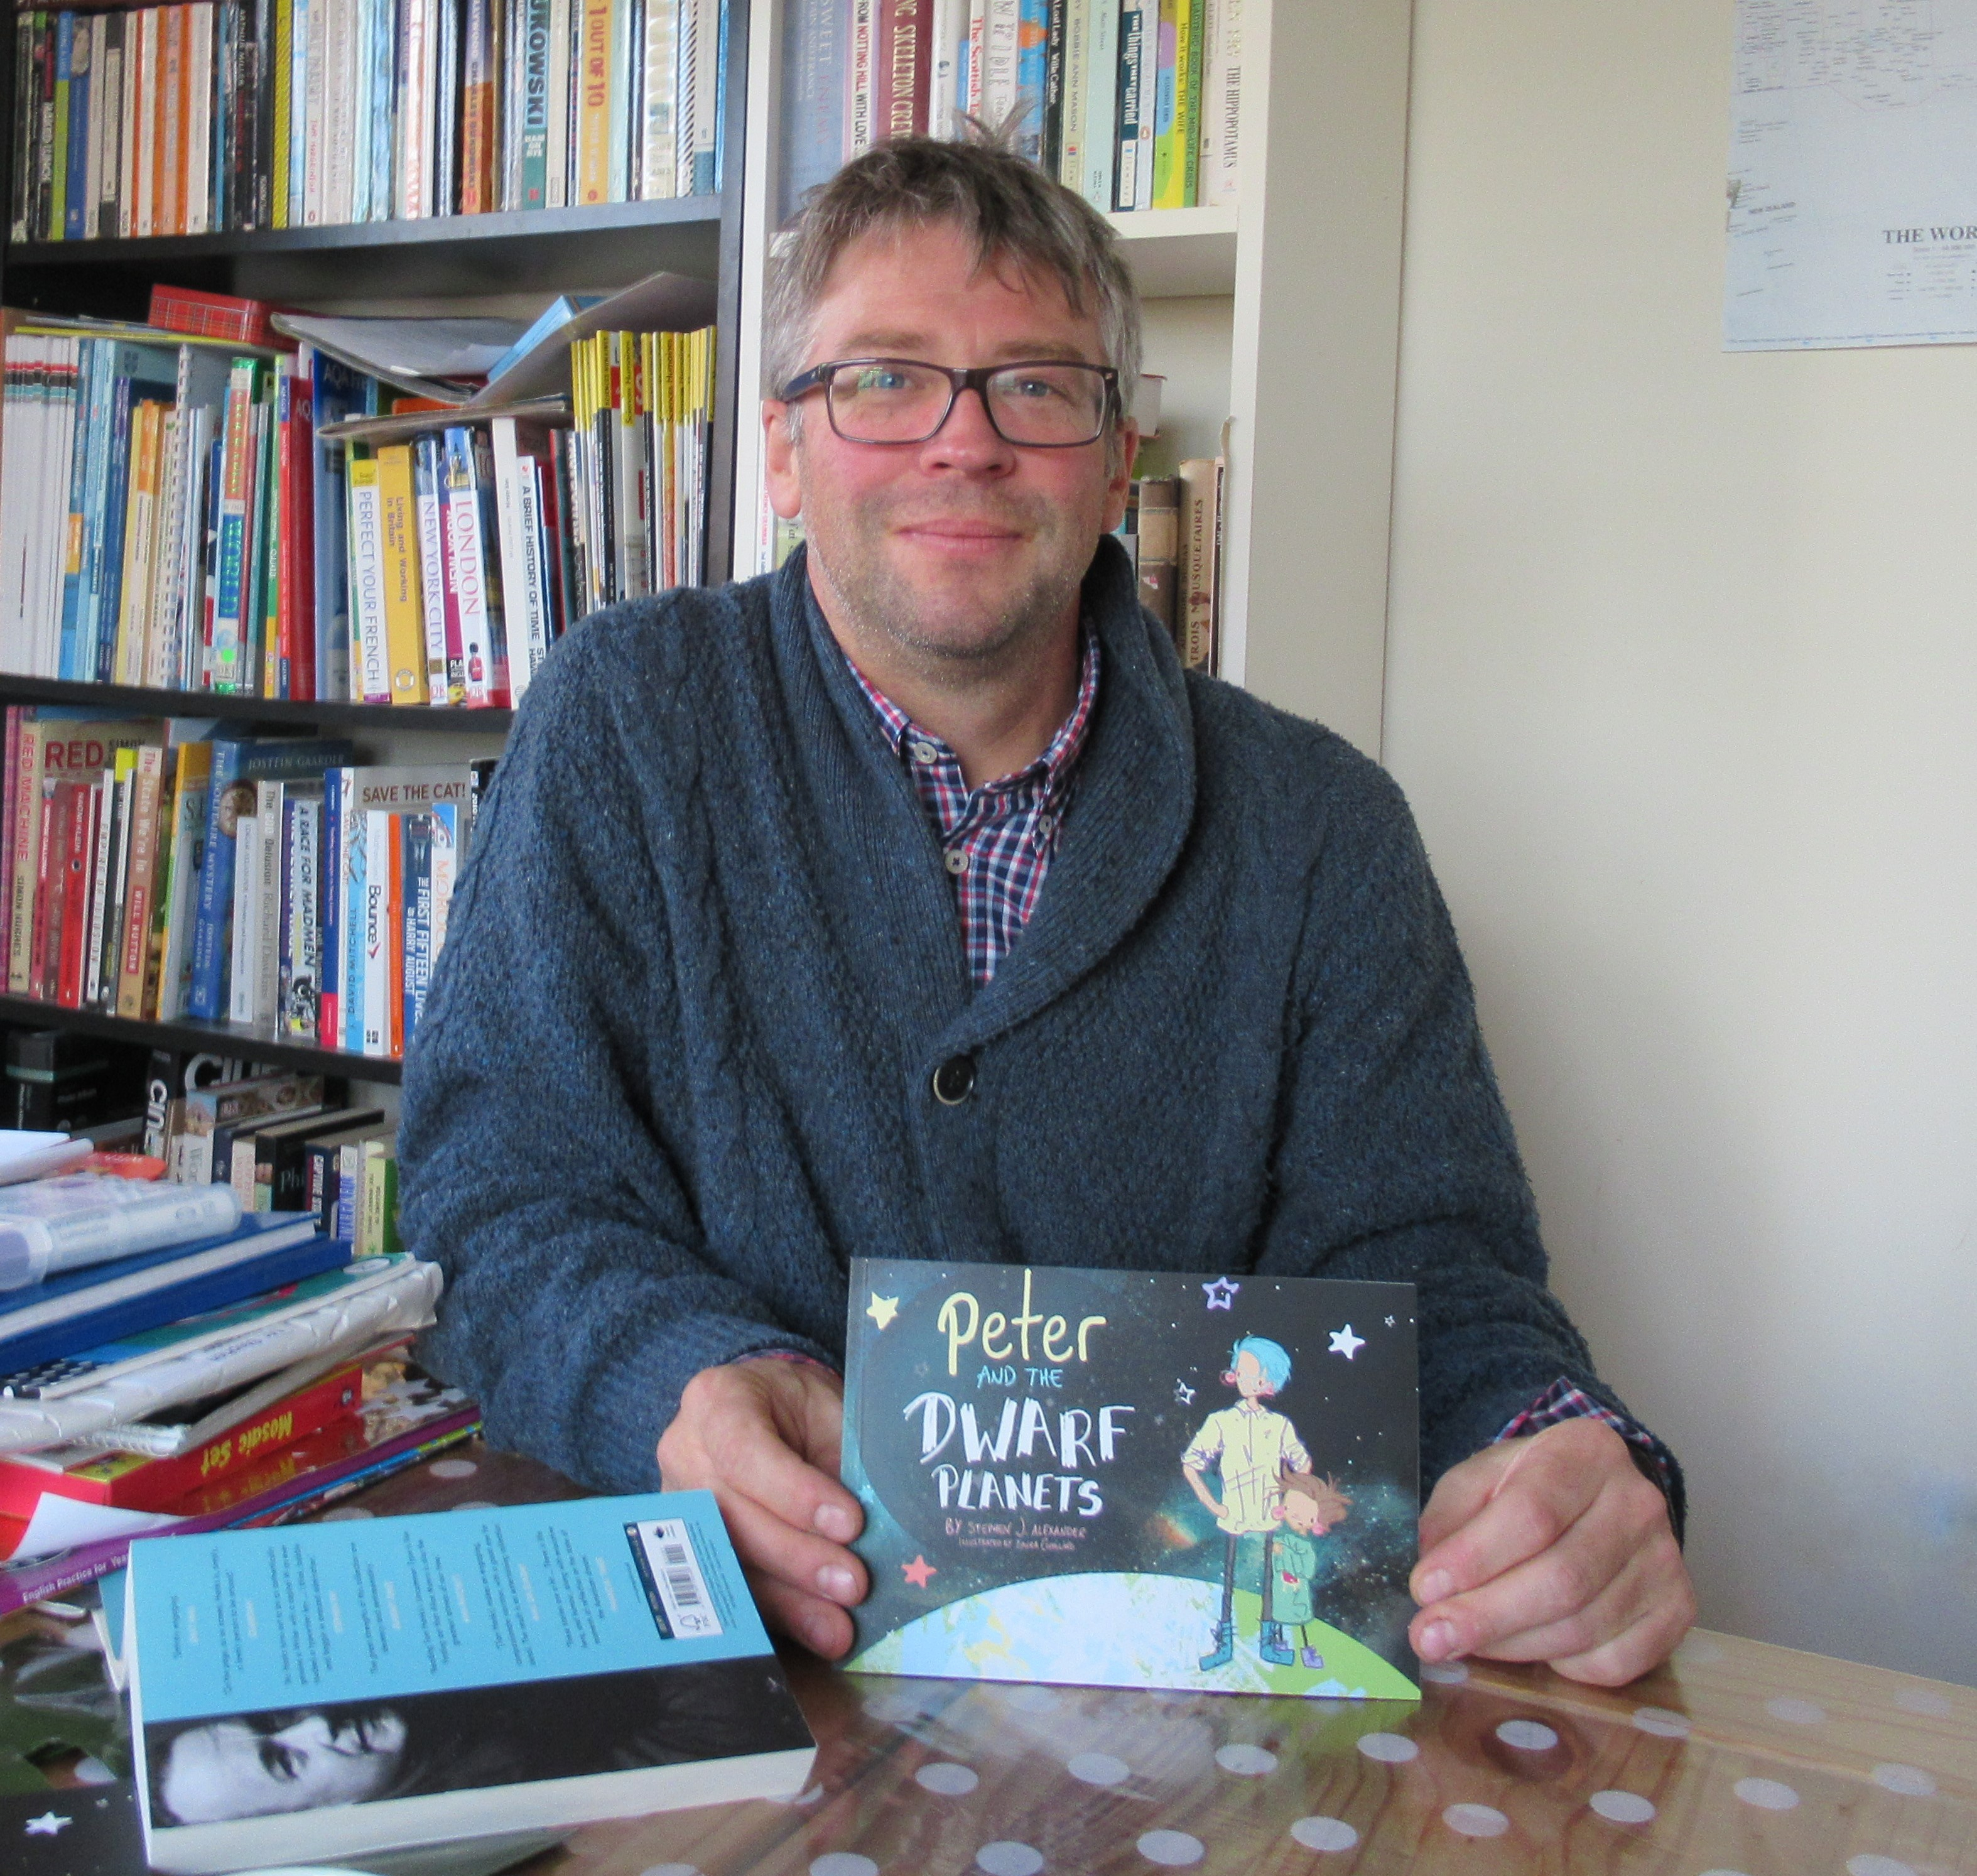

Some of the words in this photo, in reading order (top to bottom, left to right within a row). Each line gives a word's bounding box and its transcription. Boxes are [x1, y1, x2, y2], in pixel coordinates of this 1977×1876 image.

[471, 0, 481, 57] LLYWOOD
[857, 0, 870, 23] ROM
[1053, 4, 1062, 23] Lost
[589, 19, 604, 53] OUT
[856, 25, 870, 69] NOTTING
[972, 16, 985, 43] The
[1051, 24, 1061, 46] Lady
[1073, 18, 1081, 60] BOBBIE
[1179, 22, 1188, 42] How
[528, 0, 547, 125] UKOWSKI
[891, 24, 917, 99] SKELETON
[1051, 52, 1061, 73] Willa
[1122, 31, 1141, 65] things
[1190, 51, 1199, 75] BOOK
[588, 57, 605, 78] OF
[855, 70, 869, 92] HILL
[970, 45, 983, 97] Scottish
[1071, 63, 1080, 88] ANN
[1189, 80, 1198, 90] OF
[1227, 67, 1241, 85] THE
[587, 81, 607, 107] 10
[855, 93, 868, 119] WITH
[1049, 73, 1061, 104] Cather
[1123, 87, 1139, 124] carried
[1178, 90, 1186, 107] THE
[1188, 95, 1198, 113] THE
[1070, 90, 1079, 132] MASON
[1177, 111, 1186, 133] WIFE
[1223, 89, 1240, 168] HIPPOPOTAMUS
[1186, 161, 1195, 189] CRISIS
[1883, 228, 1923, 243] THE
[1930, 225, 1977, 241] WOR
[386, 496, 396, 507] in
[523, 485, 531, 495] A
[358, 491, 375, 562] PERFECT
[387, 511, 397, 547] Britain
[394, 496, 406, 529] Living
[423, 501, 438, 543] NEW
[523, 497, 533, 533] BRIEF
[398, 534, 407, 553] and
[455, 500, 481, 615] LONDON
[399, 557, 409, 602] Working
[425, 545, 441, 605] YORK
[525, 536, 536, 588] HISTORY
[361, 567, 377, 610] YOUR
[529, 590, 538, 607] OF
[428, 607, 443, 651] CITY
[531, 609, 541, 641] TIME
[1189, 621, 1200, 661] TROIS
[364, 615, 381, 681] FRENCH
[21, 733, 36, 771] RED
[45, 739, 104, 769] RED
[144, 752, 156, 773] The
[215, 752, 225, 777] THE
[77, 791, 85, 823] NAOMI
[139, 778, 154, 813] State
[266, 790, 276, 809] The
[362, 784, 399, 803] SAVE
[403, 784, 430, 801] THE
[433, 781, 466, 799] CAT!
[17, 776, 34, 862] MACHINE
[209, 781, 222, 848] SOLITAIRE
[300, 806, 310, 815] A
[98, 823, 109, 873] EMPIRE
[300, 820, 311, 853] RACE
[264, 838, 274, 885] Delusion
[301, 855, 312, 884] FOR
[203, 852, 217, 911] MYSTERY
[133, 890, 143, 919] WILL
[262, 892, 274, 941] Richard
[368, 884, 382, 943] Bounce
[417, 888, 430, 926] FIRST
[302, 889, 316, 967] MADMEN
[349, 908, 357, 970] MITCHELL
[406, 918, 416, 953] HARRY
[129, 924, 140, 970] HUTTON
[416, 930, 429, 986] FIFTEEN
[261, 945, 273, 1000] Dawkins
[404, 955, 415, 995] AUGUST
[937, 1267, 1107, 1377] Peter
[977, 1365, 1017, 1389] AND
[1024, 1367, 1063, 1389] THE
[236, 1411, 294, 1457] Mosaic
[902, 1391, 1135, 1468] DWARF
[198, 1442, 233, 1477] Set
[930, 1463, 1103, 1516] PLANETS
[945, 1517, 961, 1536] BY
[968, 1521, 1012, 1536] STEPHEN
[1031, 1523, 1088, 1539] ALEXANDER
[22, 1581, 56, 1604] English
[57, 1567, 92, 1591] Practice
[94, 1561, 107, 1576] for
[110, 1552, 129, 1569] Yea
